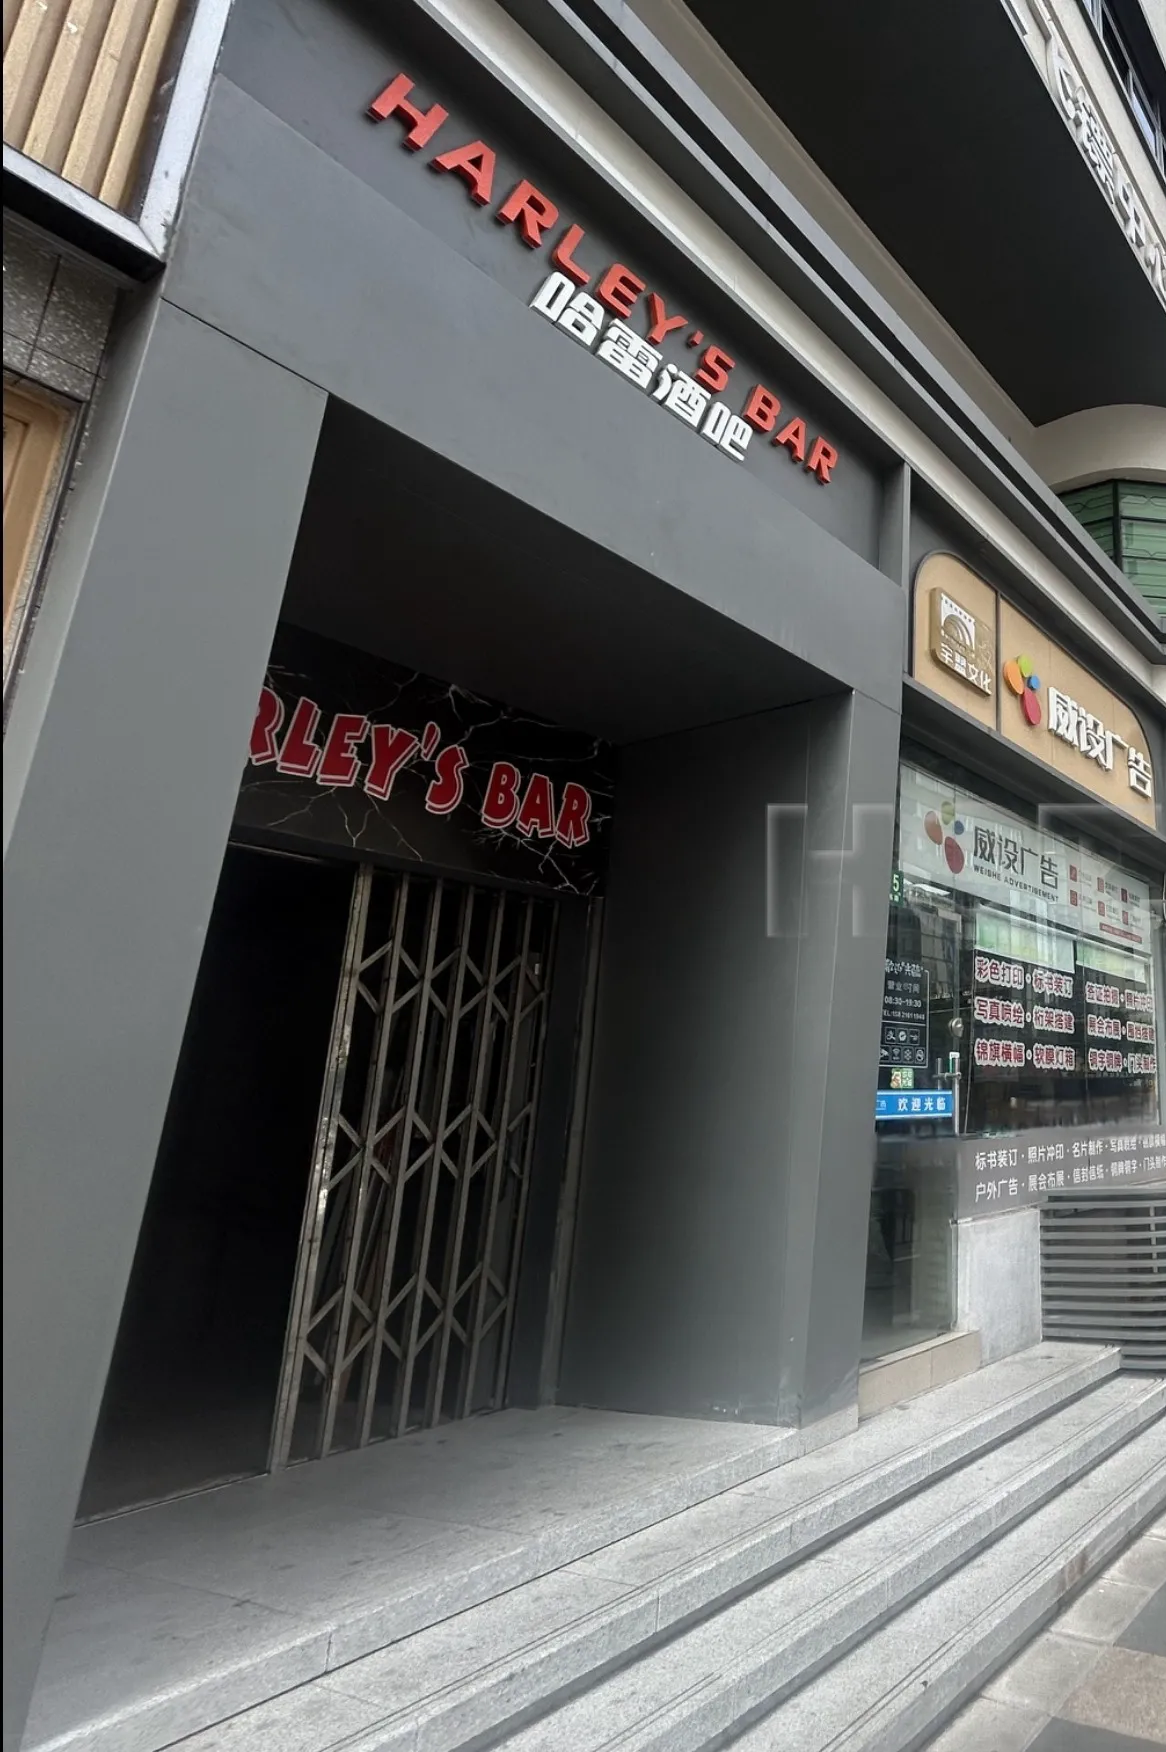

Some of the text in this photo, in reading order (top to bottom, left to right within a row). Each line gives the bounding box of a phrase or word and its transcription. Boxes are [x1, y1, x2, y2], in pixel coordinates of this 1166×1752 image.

[366, 73, 839, 485] HARLEY'S BAR
[529, 271, 753, 463] 哈雷酒吧
[1048, 687, 1152, 798] 威设广告
[481, 761, 592, 849] BAR
[974, 825, 1059, 889] 威设广告
[887, 979, 920, 994] 营业时间
[974, 956, 1073, 998] 彩色打印 标书装订
[974, 996, 1075, 1034] 写真喷绘 桁架搭建
[974, 1038, 1075, 1071] 锦旗横幅 软膜灯箱
[898, 1096, 946, 1111] 欢迎光临
[975, 1148, 1018, 1171] 标书装订
[1028, 1143, 1064, 1163] 照片冲印
[1072, 1138, 1103, 1158] 名片制作
[975, 1178, 1018, 1203] 户外广告
[1028, 1170, 1064, 1192] 展会布展
[1073, 1164, 1104, 1184] 信封信纸
